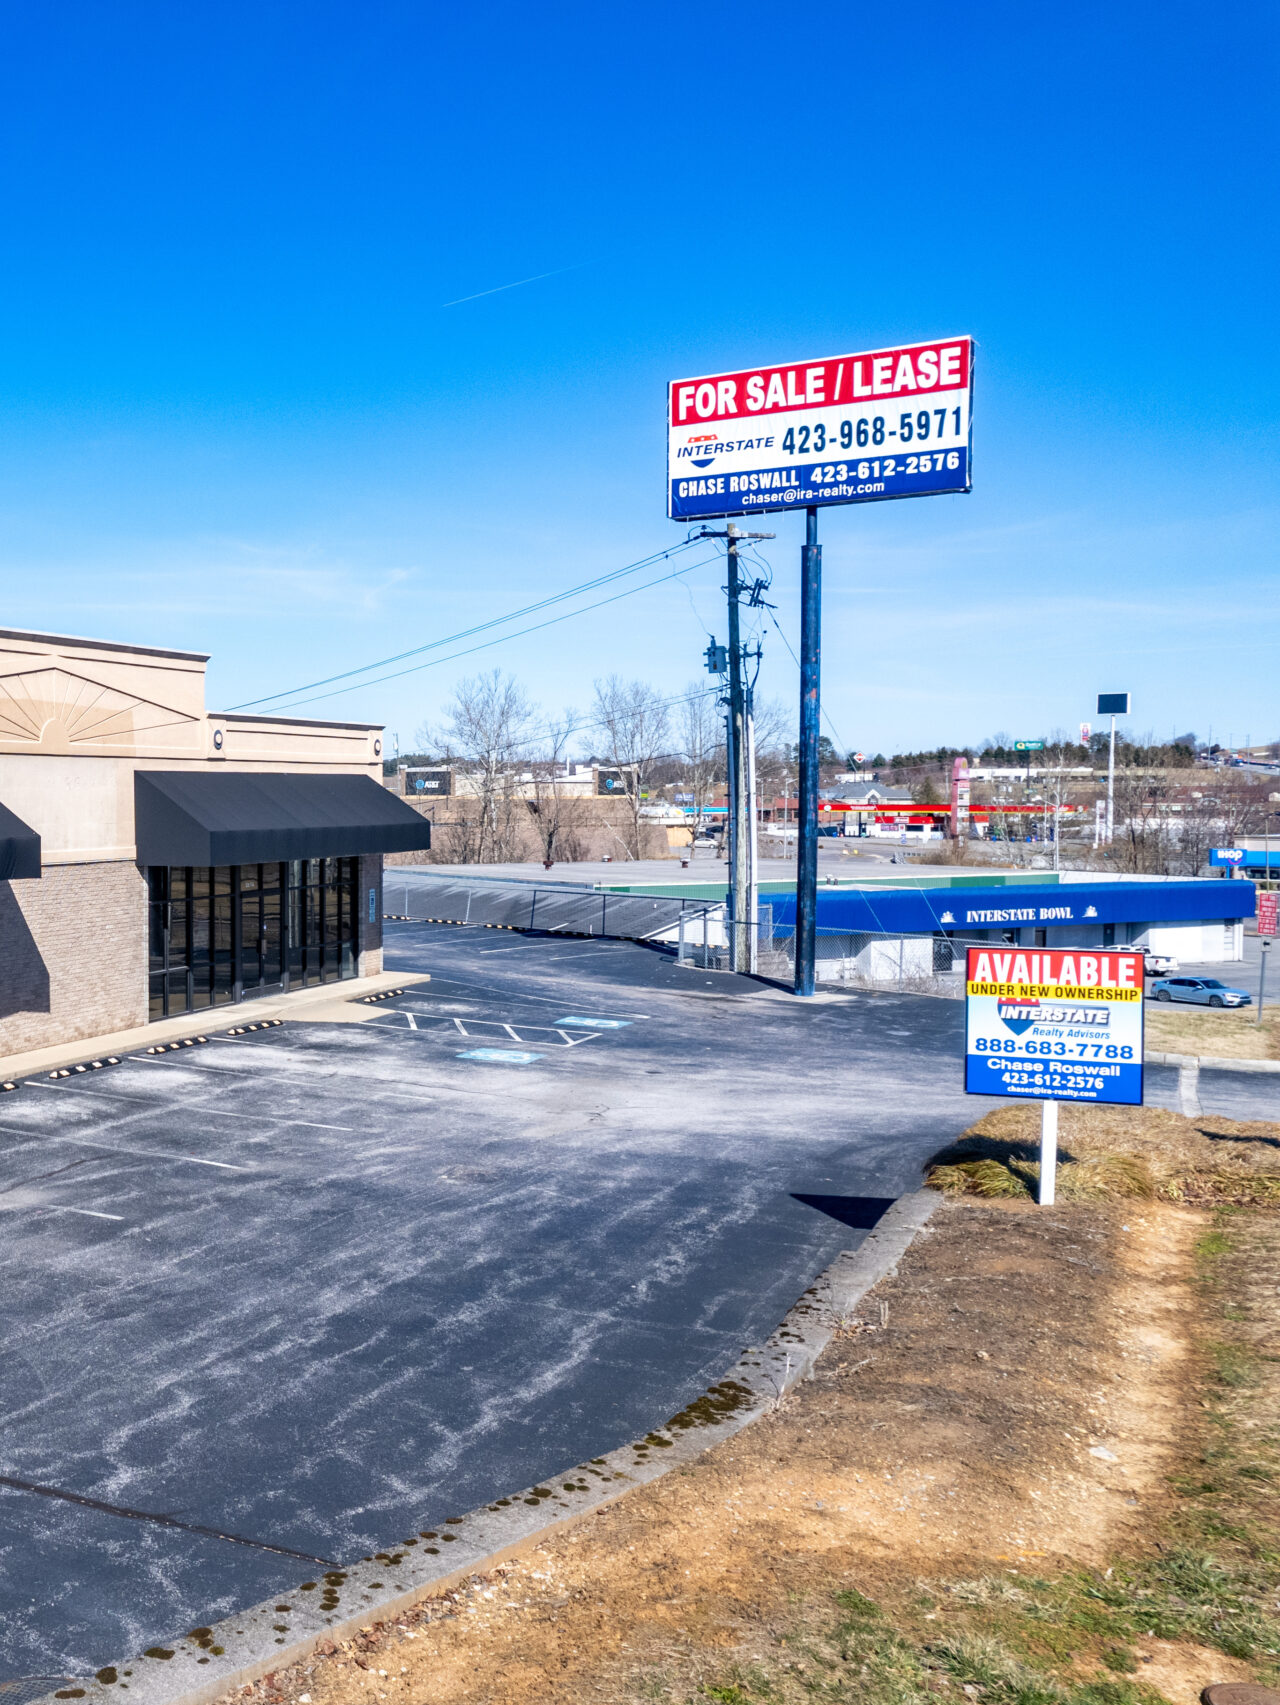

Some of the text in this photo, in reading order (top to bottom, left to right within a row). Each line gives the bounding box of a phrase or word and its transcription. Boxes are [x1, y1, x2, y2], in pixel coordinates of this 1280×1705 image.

[679, 381, 737, 420] FOR
[746, 366, 825, 411] SALE
[853, 347, 961, 397] LEASE
[782, 406, 961, 455] 423-968-5971
[677, 436, 774, 458] INTERSTATE
[679, 452, 959, 497] CHASE ROSWALL 423-612-2576
[742, 482, 884, 505] chaser@ira-realty.com
[967, 907, 1073, 923] INTERSTATE BOWL
[975, 953, 1135, 987] AVAILABLE
[972, 984, 1137, 1000] UNDER NEW OWNERSHIP
[1001, 1007, 1109, 1024] INTERSTATE
[1033, 1028, 1110, 1039] Realty Advisors
[976, 1038, 1133, 1059] 888-683-7788
[987, 1058, 1120, 1076] Chase Roswall
[1002, 1072, 1104, 1089] 423-612-2576
[1007, 1086, 1096, 1097] chaser@ira-realty.com
